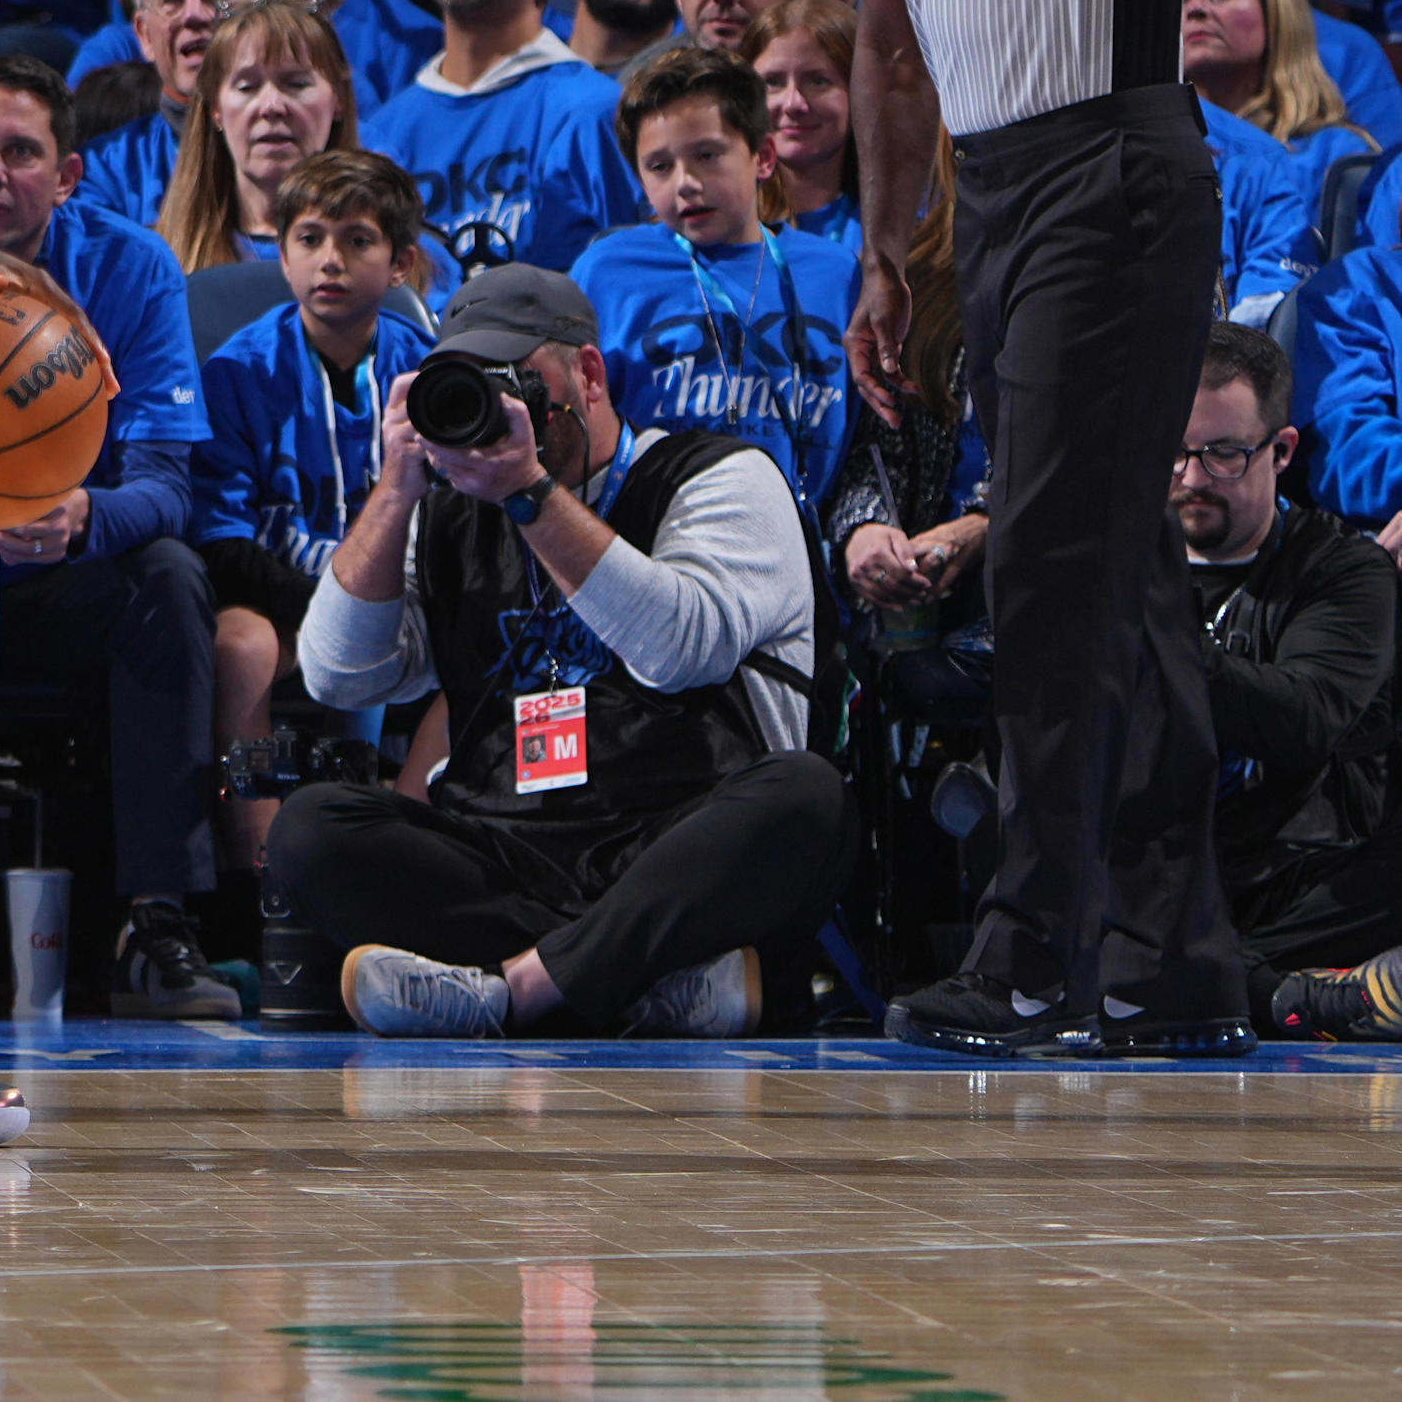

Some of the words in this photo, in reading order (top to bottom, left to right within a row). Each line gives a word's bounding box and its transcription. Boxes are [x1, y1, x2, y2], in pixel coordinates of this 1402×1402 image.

[3, 325, 95, 410] ilson
[519, 693, 581, 717] 2025
[553, 733, 578, 761] M
